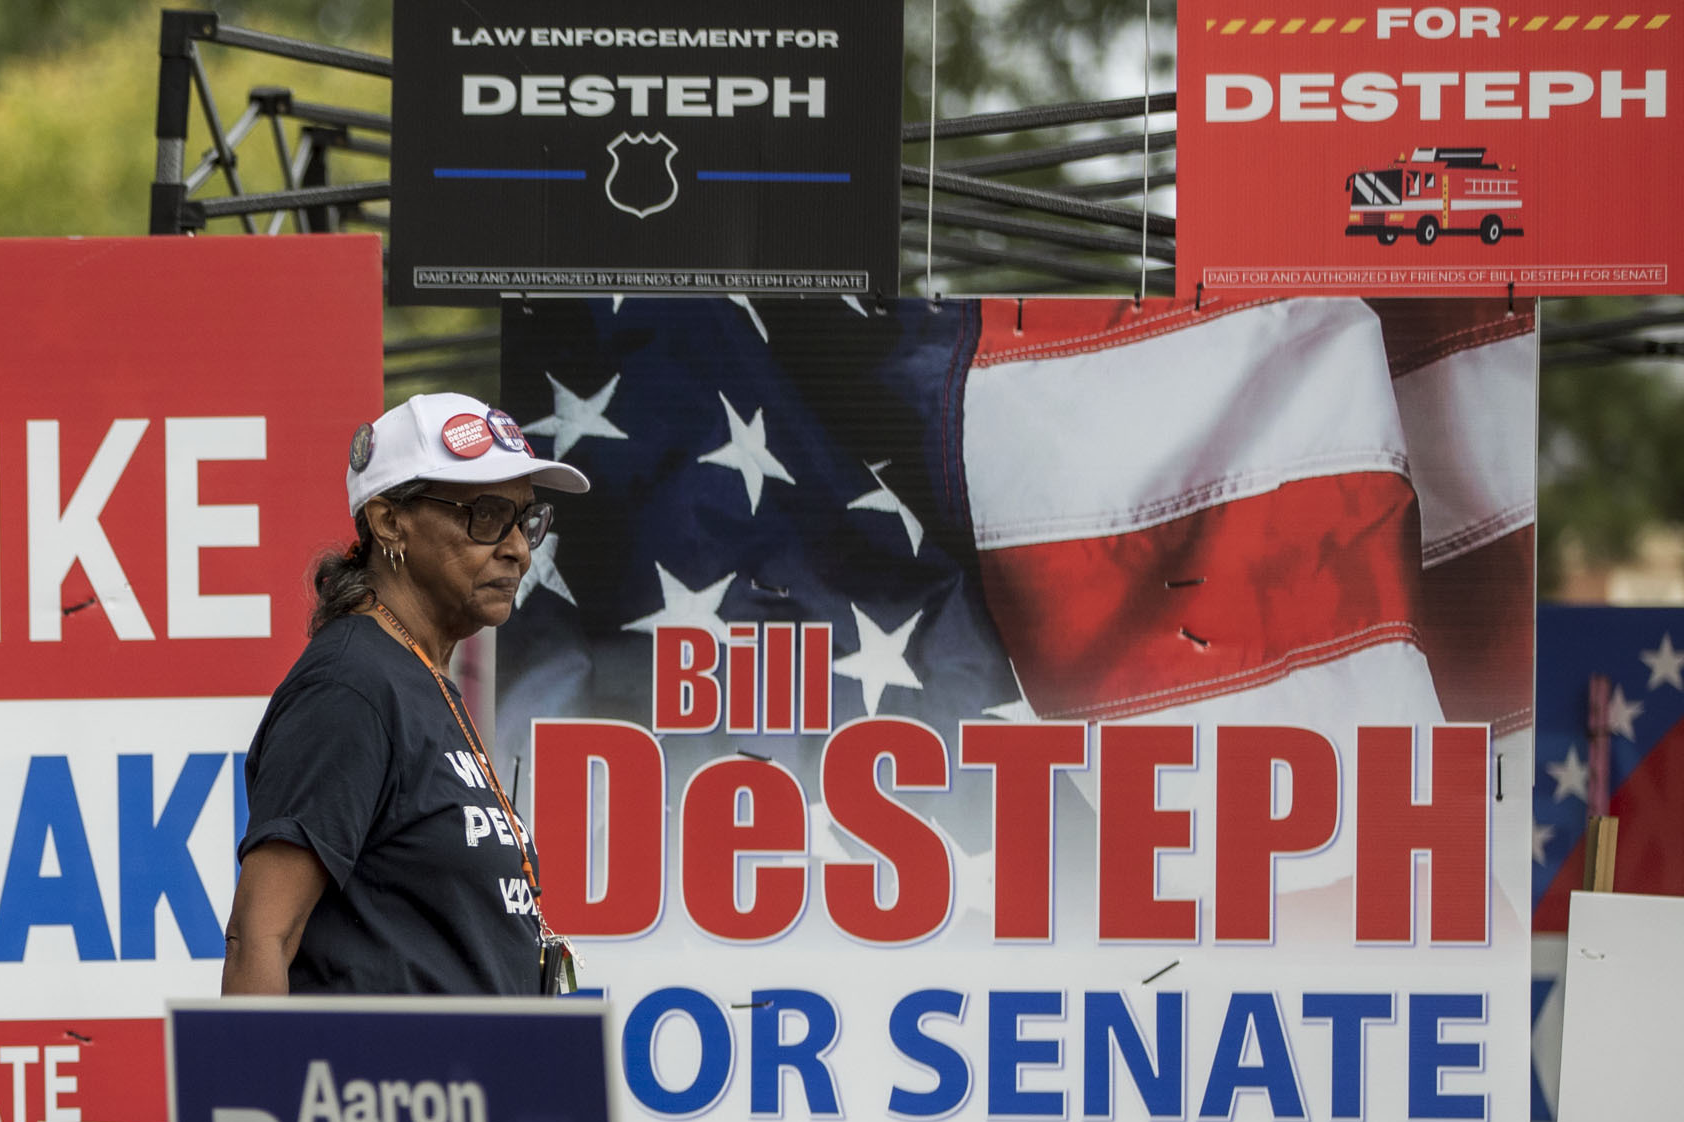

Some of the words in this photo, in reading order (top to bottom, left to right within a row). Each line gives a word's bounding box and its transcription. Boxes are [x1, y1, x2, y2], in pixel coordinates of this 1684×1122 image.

[452, 28, 526, 46] LAW
[531, 28, 771, 48] ENFORCEMENT
[776, 30, 839, 48] FOR
[1377, 7, 1501, 39] FOR
[462, 75, 826, 118] DESTEPH
[1206, 70, 1667, 122] DESTEPH
[418, 271, 450, 284] PAID
[452, 271, 479, 284] FOR
[481, 272, 510, 285] AND
[512, 272, 595, 285] AUTHORIZED
[597, 273, 616, 286] BY
[617, 273, 671, 286] FRIENDS
[673, 273, 695, 286] OF
[696, 274, 722, 287] BILL
[725, 274, 783, 287] DESTEPH
[786, 275, 813, 288] FOR
[816, 275, 864, 288] SENATE
[1208, 272, 1238, 284] PAID
[1242, 272, 1269, 284] FOR
[1271, 271, 1301, 283] AND
[1304, 271, 1388, 283] AUTHORIZED
[1390, 271, 1407, 283] BY
[1410, 271, 1466, 283] FRIENDS
[1468, 271, 1486, 283] OF
[1490, 270, 1516, 282] BILL
[1520, 270, 1579, 282] DESTEPH
[1583, 270, 1610, 282] FOR
[1613, 269, 1663, 281] SENATE
[447, 425, 483, 443] DEMAND
[452, 433, 482, 449] ACTION
[652, 623, 833, 735] Bill
[529, 716, 1494, 945] DeSTEPH
[580, 986, 844, 1120] OR
